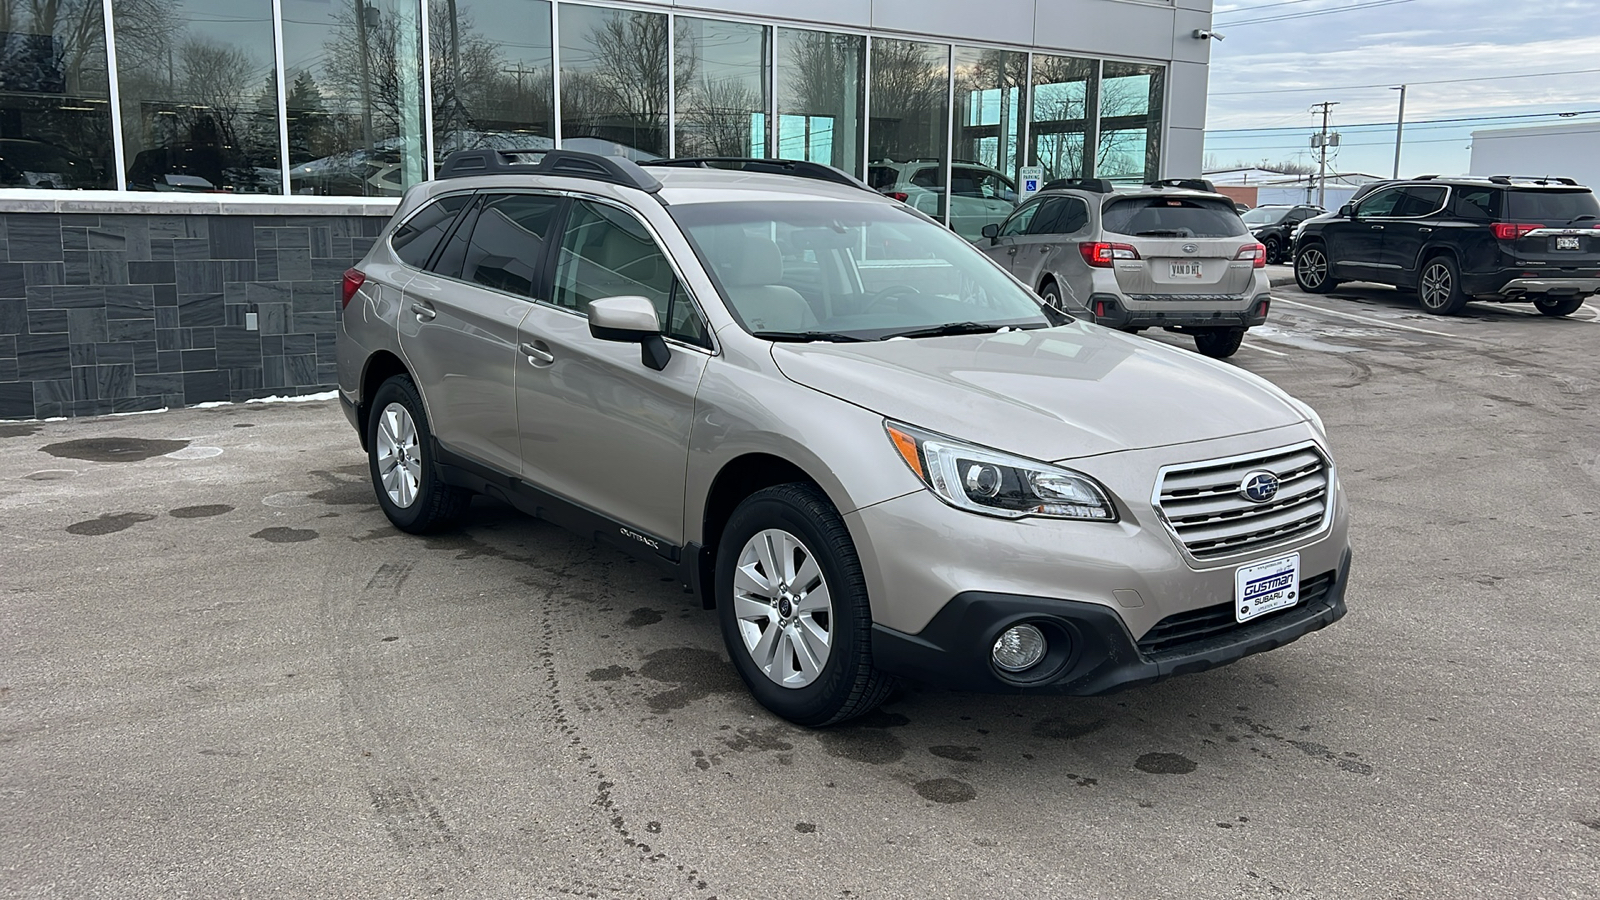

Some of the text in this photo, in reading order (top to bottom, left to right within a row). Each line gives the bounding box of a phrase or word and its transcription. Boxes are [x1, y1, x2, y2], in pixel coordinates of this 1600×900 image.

[1172, 265, 1184, 275] VAN
[620, 527, 659, 550] OUTBACK
[1254, 591, 1284, 606] SUBARU
